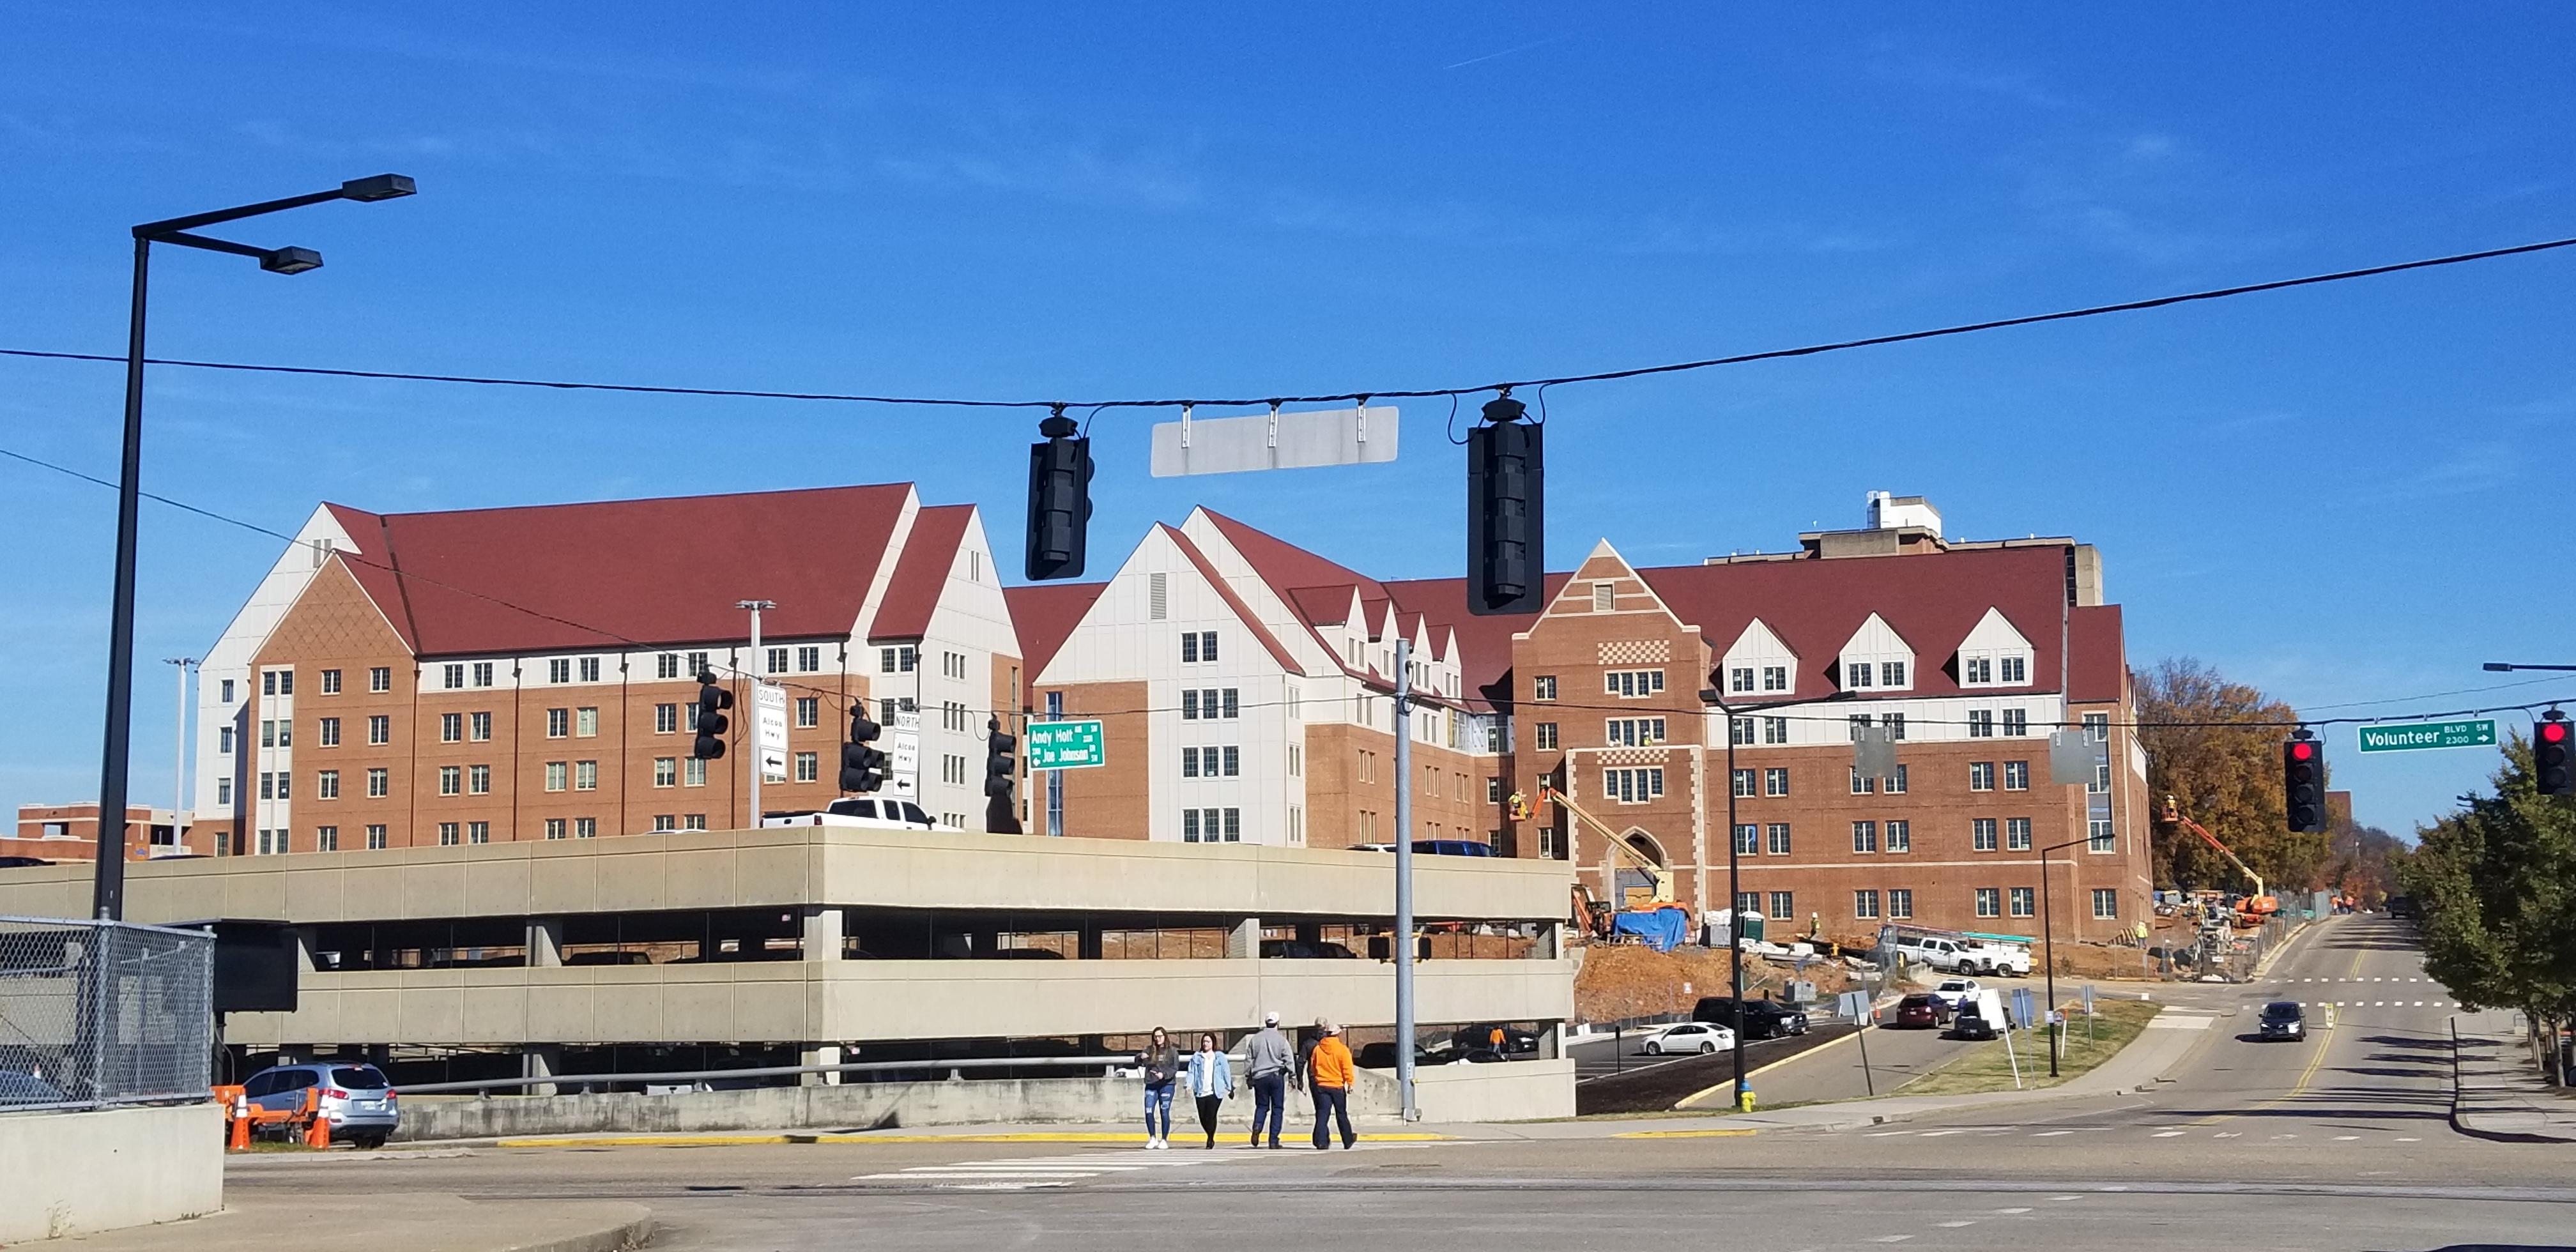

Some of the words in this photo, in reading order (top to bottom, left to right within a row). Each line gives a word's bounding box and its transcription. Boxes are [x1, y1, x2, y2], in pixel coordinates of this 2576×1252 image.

[758, 690, 785, 704] SOUTH
[763, 717, 783, 727] Alcoa
[896, 715, 920, 728] NORTH
[765, 729, 780, 740] Hwy
[1031, 730, 1052, 747] Andy
[1055, 728, 1073, 743] Holt
[2366, 731, 2440, 746] Volunteer
[2444, 725, 2467, 733] BLVD
[2476, 723, 2489, 732] SW
[2446, 735, 2469, 744] 2300
[898, 754, 912, 764] Hwy
[1043, 749, 1055, 763] Joe
[1059, 747, 1089, 762] Johnson
